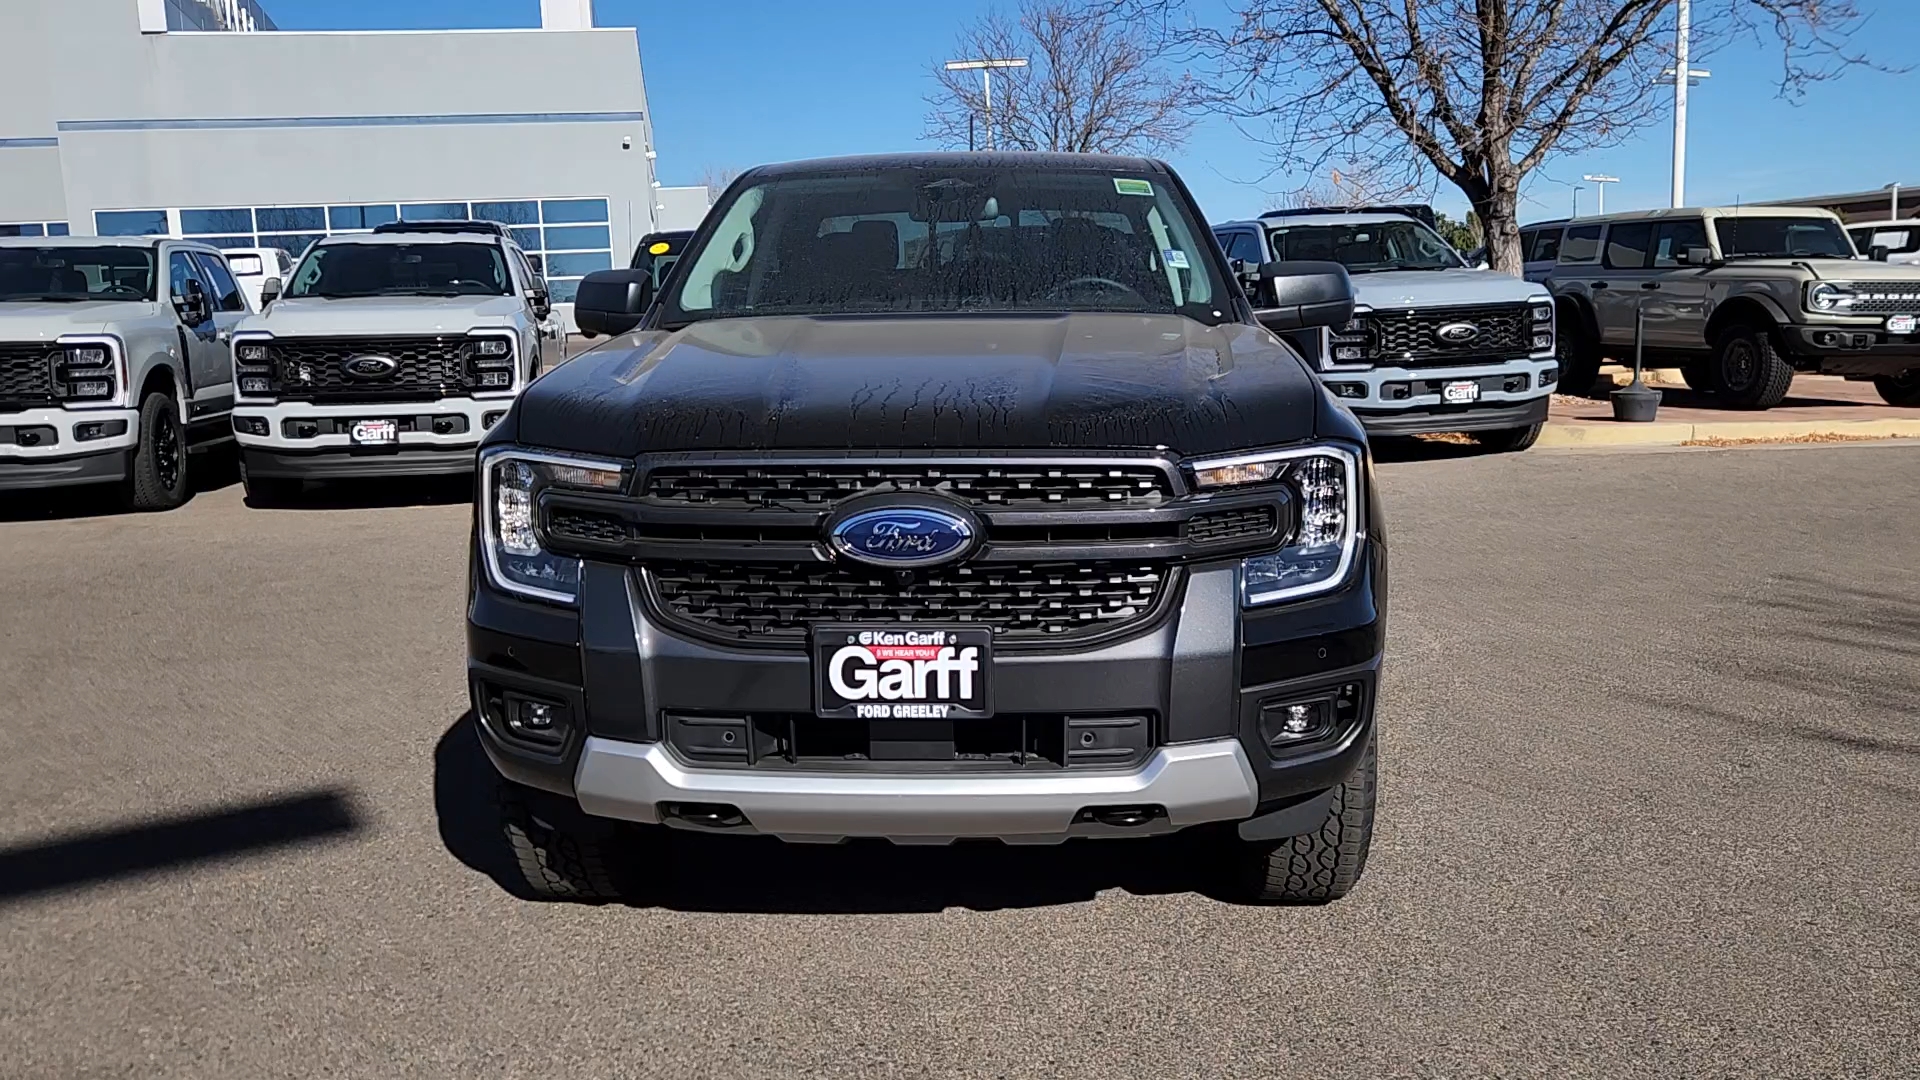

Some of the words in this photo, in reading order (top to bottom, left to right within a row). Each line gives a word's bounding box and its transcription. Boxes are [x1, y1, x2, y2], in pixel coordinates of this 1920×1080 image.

[1444, 384, 1479, 400] Garff
[352, 424, 395, 441] Garff
[866, 521, 939, 552] Ford
[873, 631, 904, 646] Ken
[905, 631, 945, 646] Garff
[882, 649, 893, 657] WE
[894, 649, 914, 657] HEAR
[915, 649, 930, 657] YOU
[829, 645, 978, 700] Garff
[857, 704, 891, 719] FORD
[892, 704, 949, 719] GREELEY
